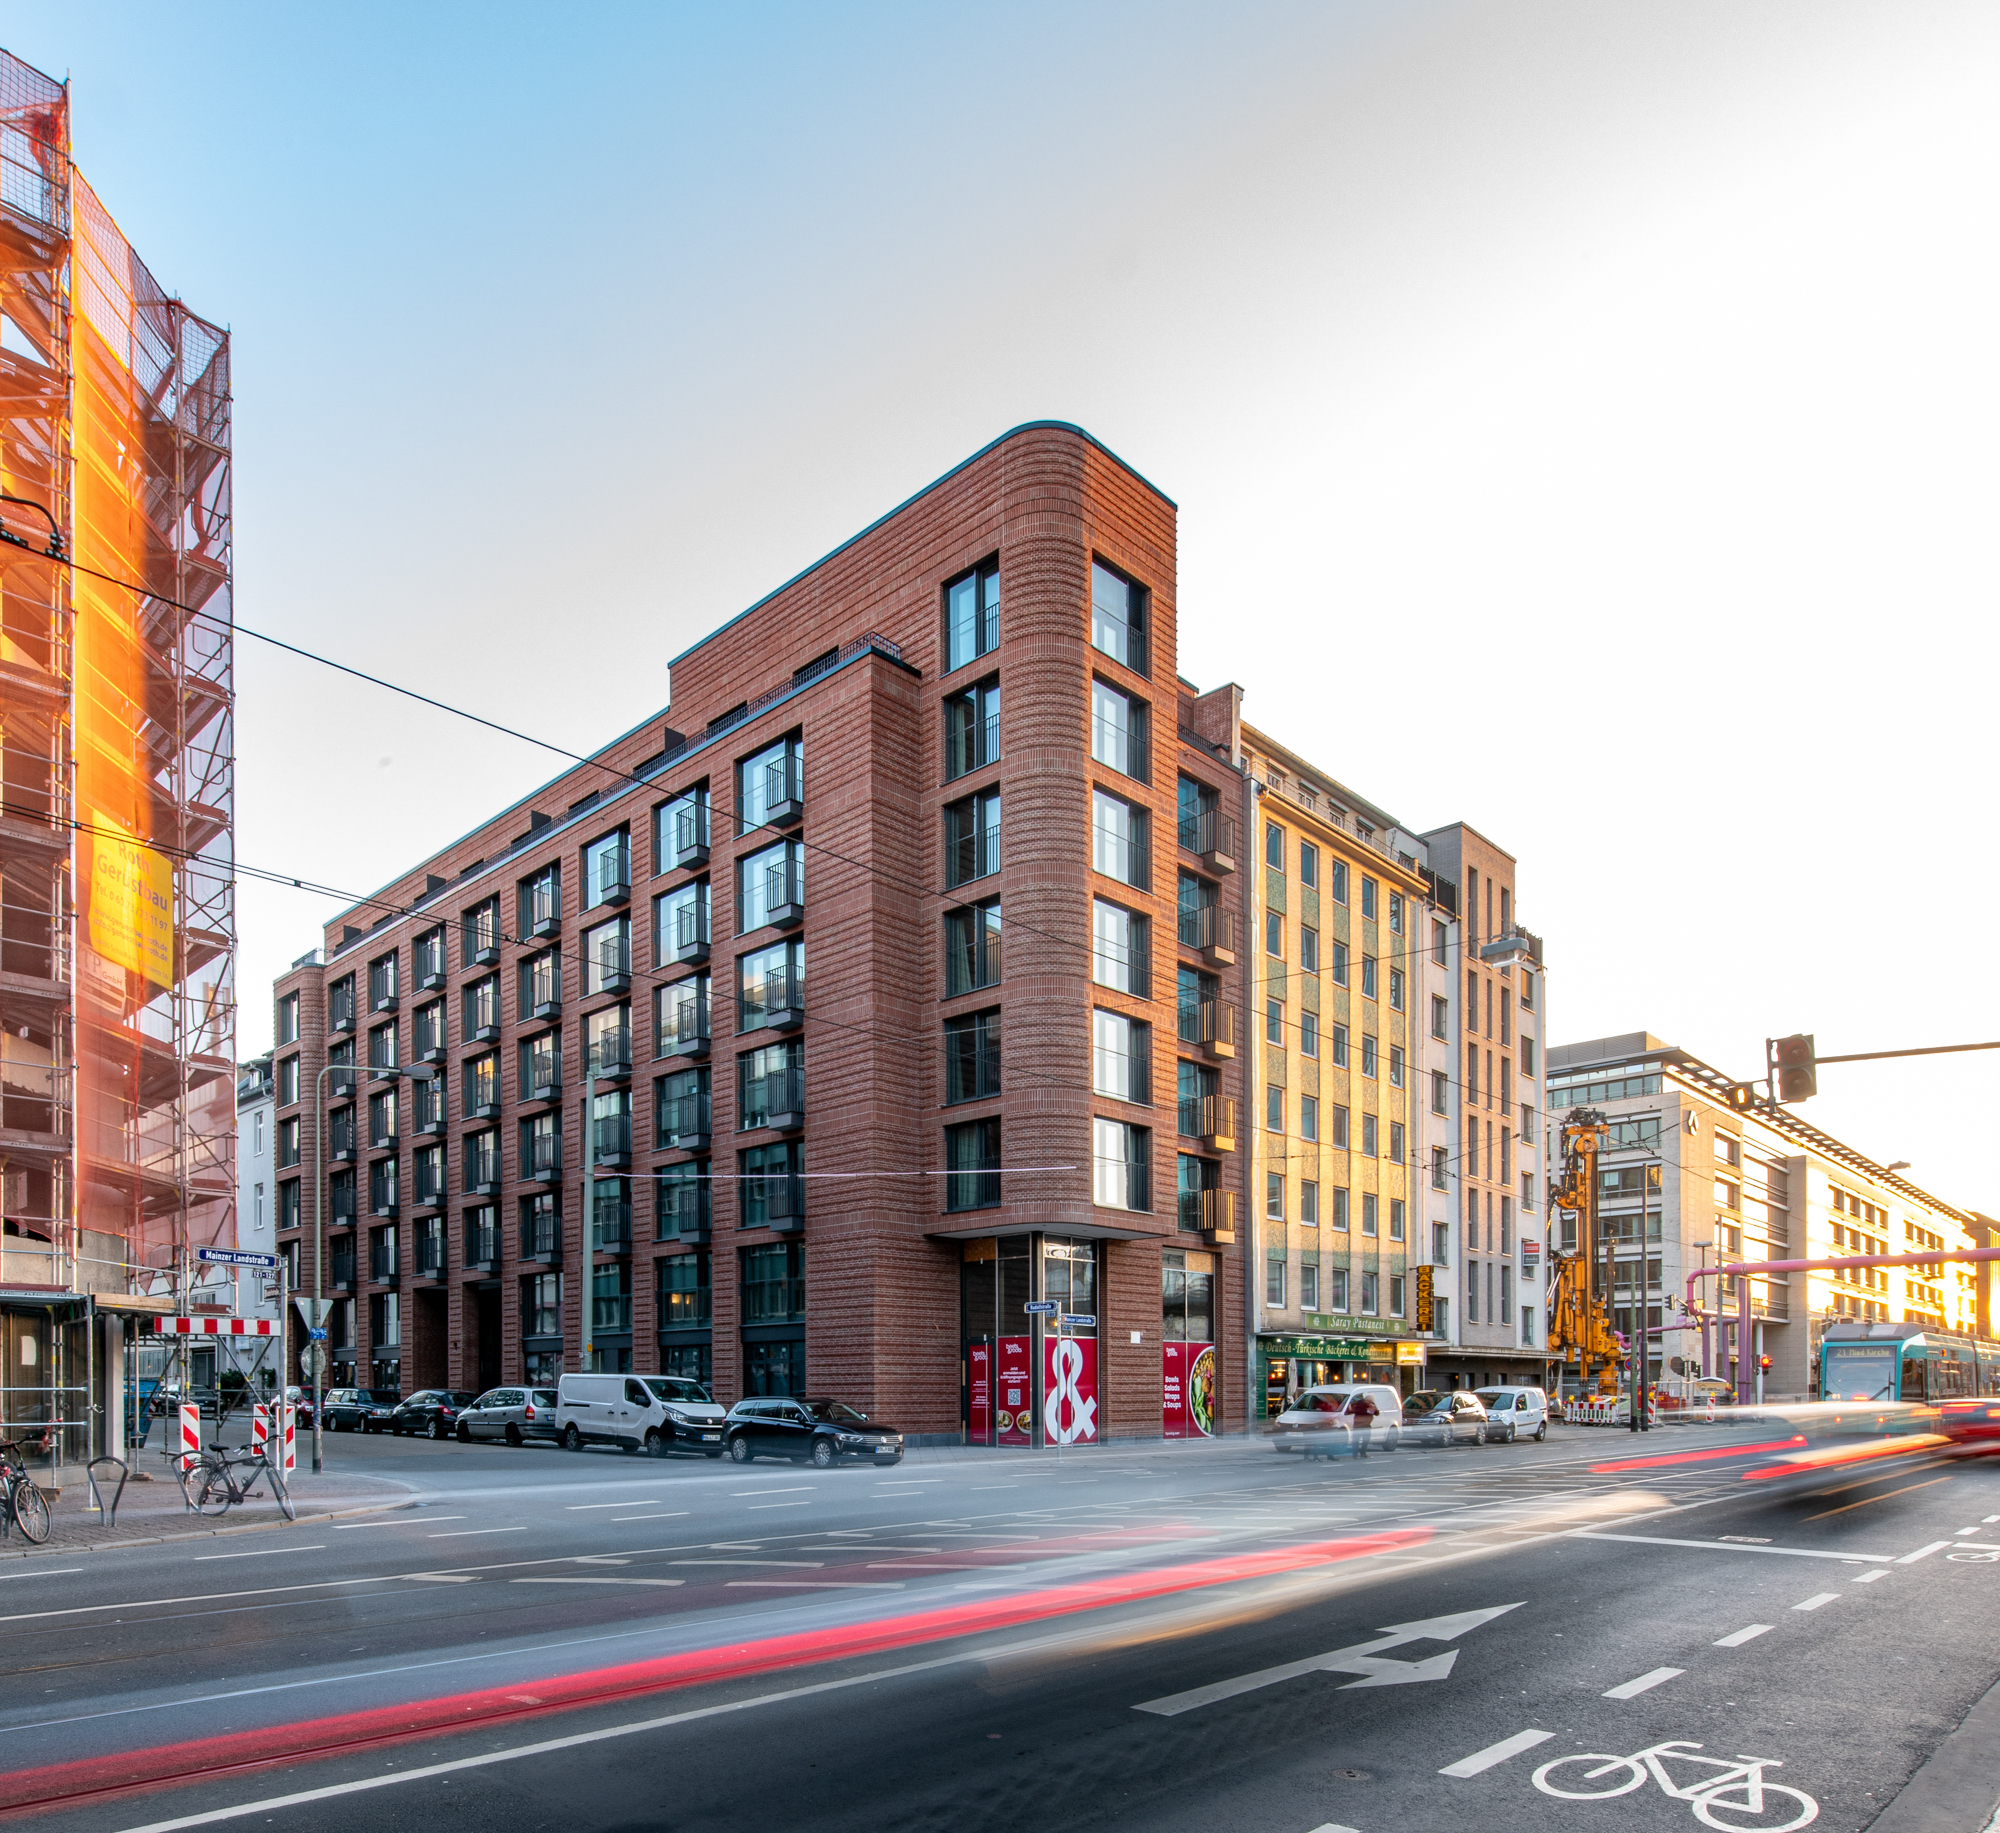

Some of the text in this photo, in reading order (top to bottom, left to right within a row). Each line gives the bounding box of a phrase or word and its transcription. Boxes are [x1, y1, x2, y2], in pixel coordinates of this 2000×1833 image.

[119, 842, 150, 875] Roth
[97, 854, 168, 912] Gerüstbau
[95, 882, 108, 898] Tel.
[150, 915, 157, 926] 11
[159, 920, 168, 931] 97
[82, 948, 101, 973] TP
[102, 971, 123, 987] GmbH
[205, 1250, 269, 1265] Mainzer Landstraße
[253, 1271, 275, 1279] 121-127
[1418, 1266, 1431, 1331] BÄCKEREI
[1330, 1315, 1385, 1331] Saray Pastanesi
[1325, 1343, 1350, 1357] Bäckerei
[1849, 1348, 1865, 1356] Nied
[1866, 1348, 1890, 1356] Kirche
[1164, 1393, 1180, 1402] Wraps
[1167, 1401, 1182, 1410] Soups
